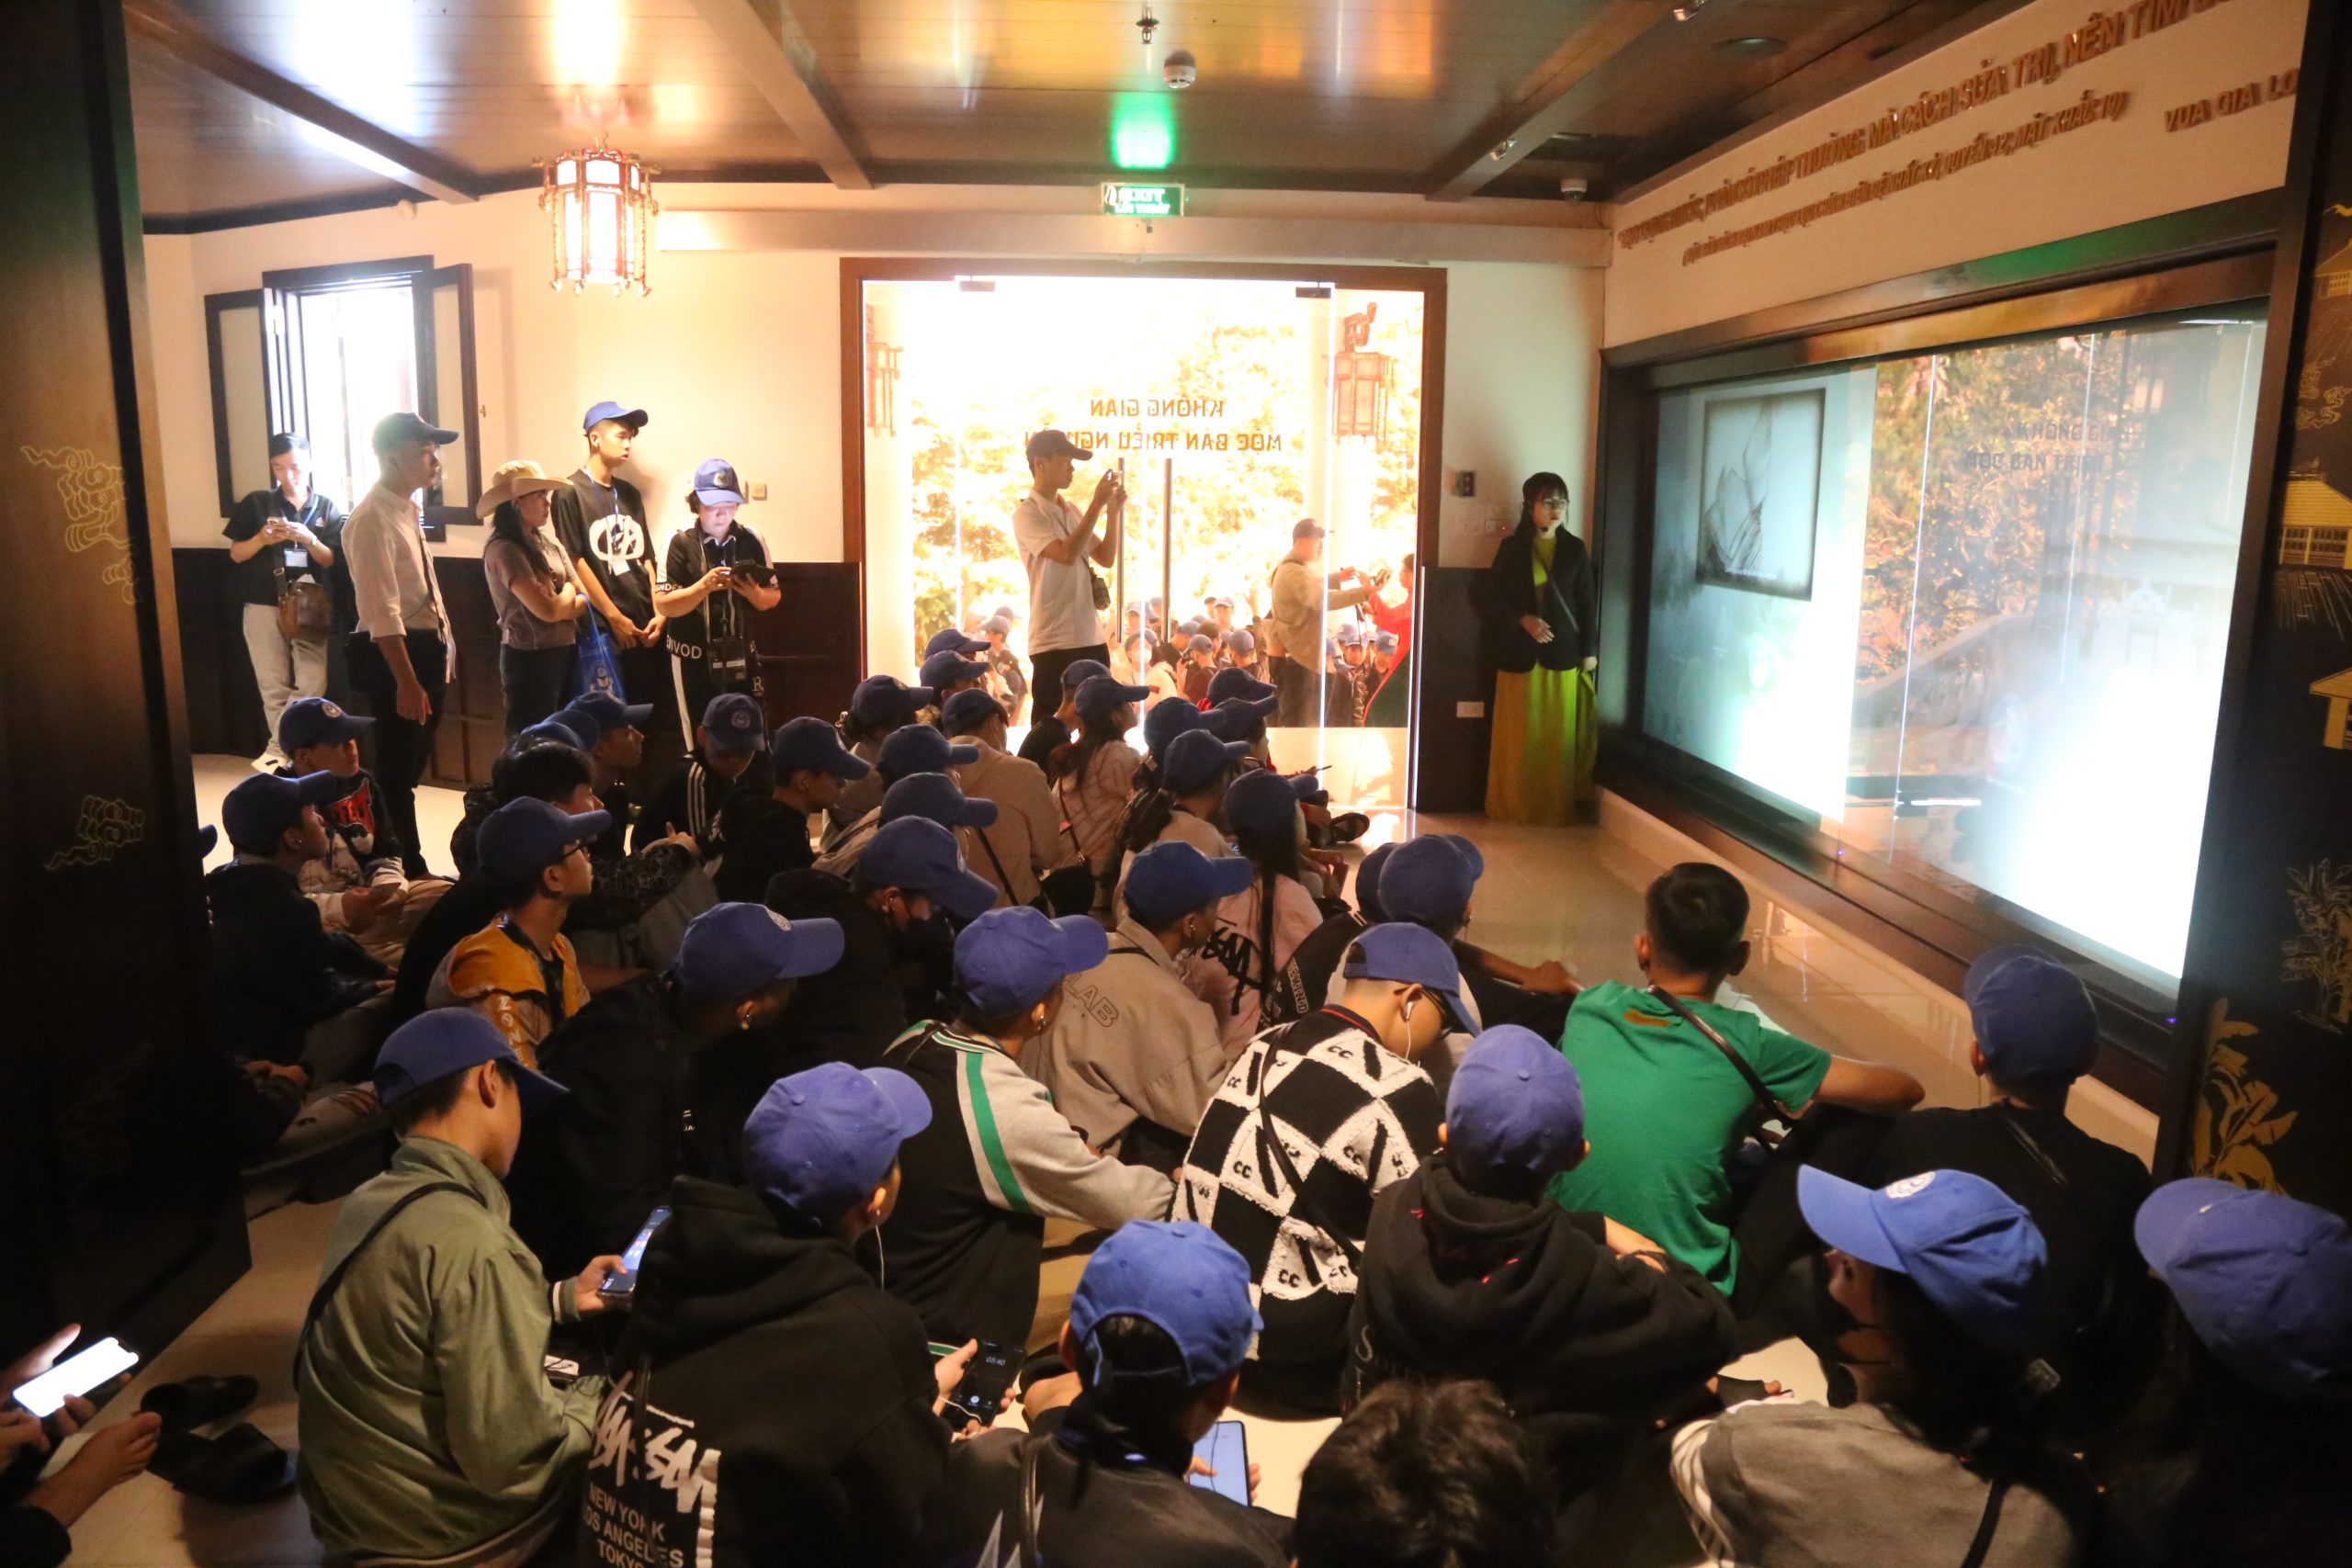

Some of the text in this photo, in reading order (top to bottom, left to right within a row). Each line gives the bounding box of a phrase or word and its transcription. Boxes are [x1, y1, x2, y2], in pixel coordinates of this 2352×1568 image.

[2165, 99, 2212, 133] VUA
[2267, 68, 2301, 101] LO
[589, 1481, 616, 1516] NEW
